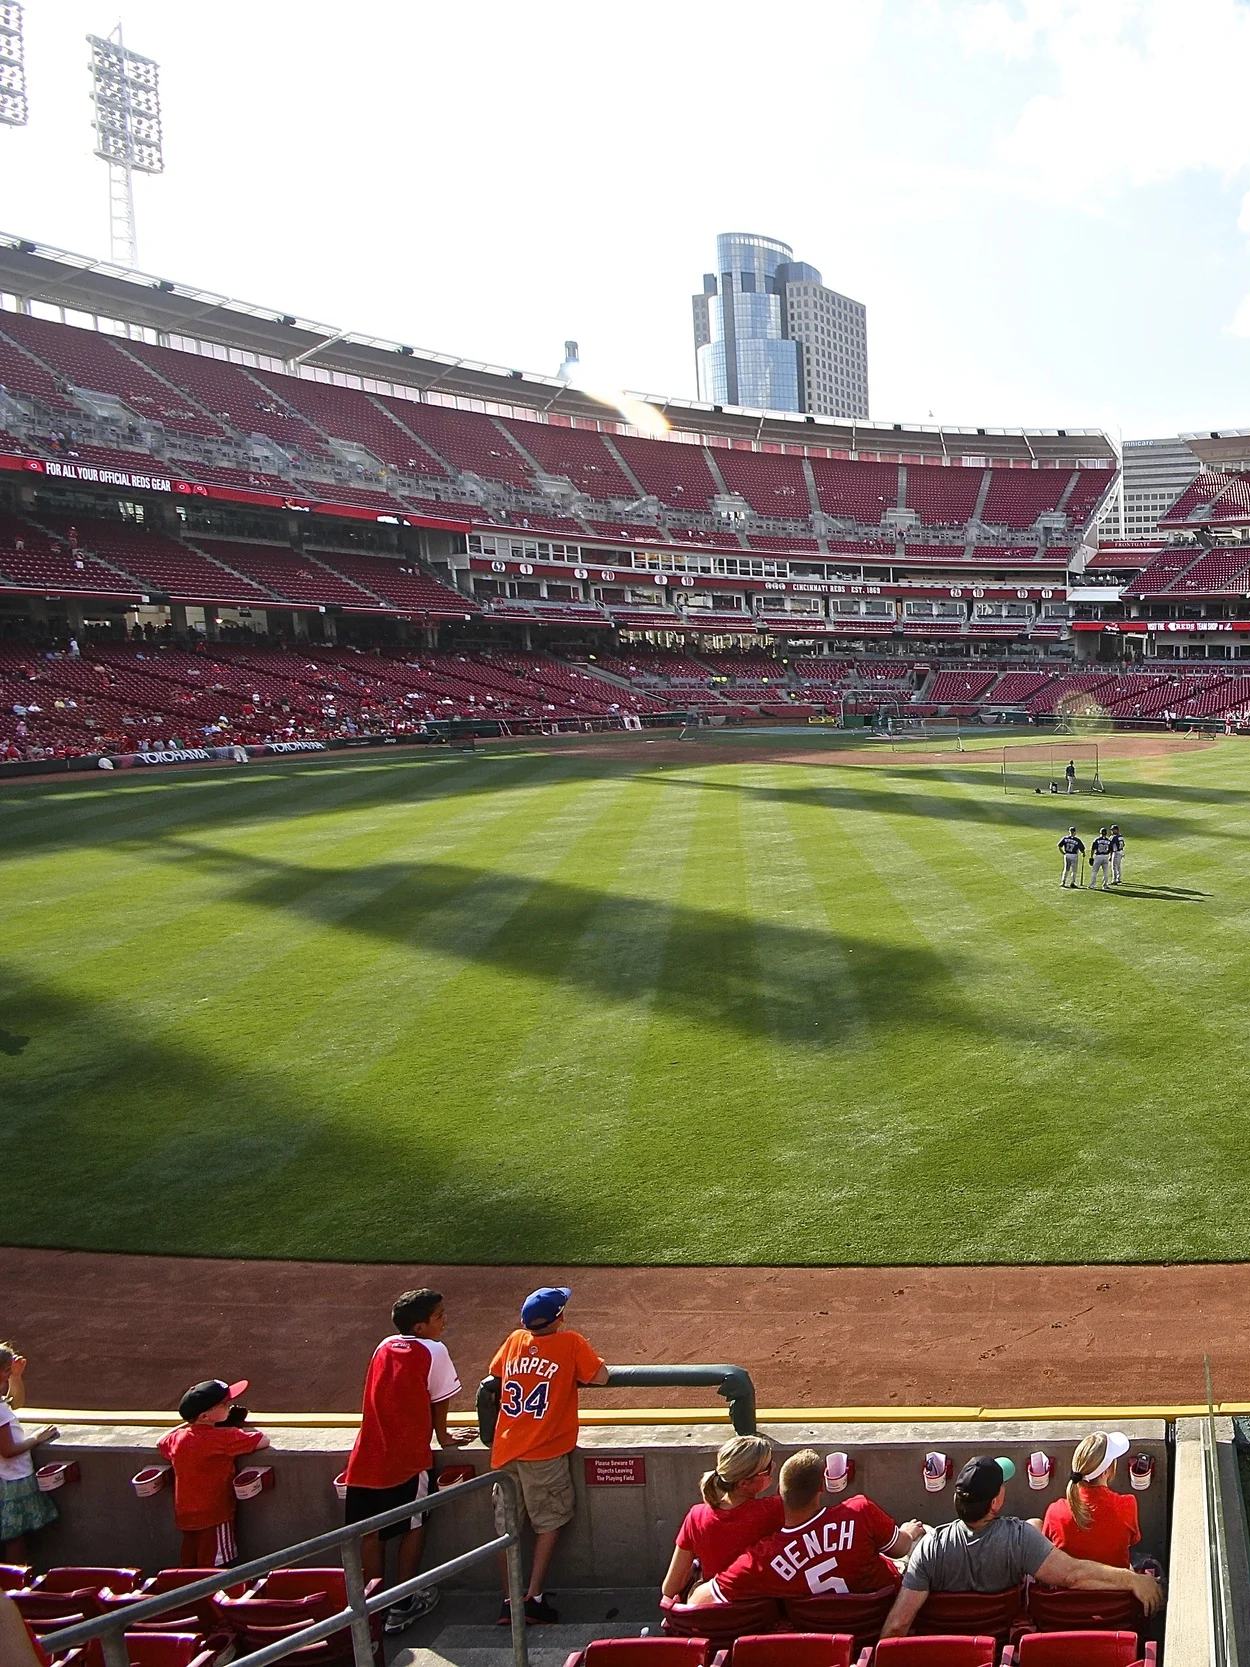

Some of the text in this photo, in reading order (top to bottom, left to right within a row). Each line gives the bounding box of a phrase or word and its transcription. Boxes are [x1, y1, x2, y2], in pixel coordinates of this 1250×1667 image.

[45, 462, 172, 492] FOR ALL YOUR OFFICIAL REDS GEAR
[603, 571, 614, 581] 20
[793, 583, 829, 592] CINCINNATI
[830, 584, 846, 593] REDS
[851, 586, 865, 594] EST.
[867, 586, 881, 594] 1869
[1176, 623, 1195, 631] REDS
[1197, 623, 1207, 631] TEAM
[1207, 623, 1218, 631] SHOP
[137, 749, 211, 764] YOKOHAMA
[268, 741, 326, 753] YOKOHAMA
[505, 1356, 559, 1379] HARPER
[502, 1380, 550, 1419] 34
[770, 1520, 855, 1581] BENCH
[804, 1557, 850, 1595] 5
